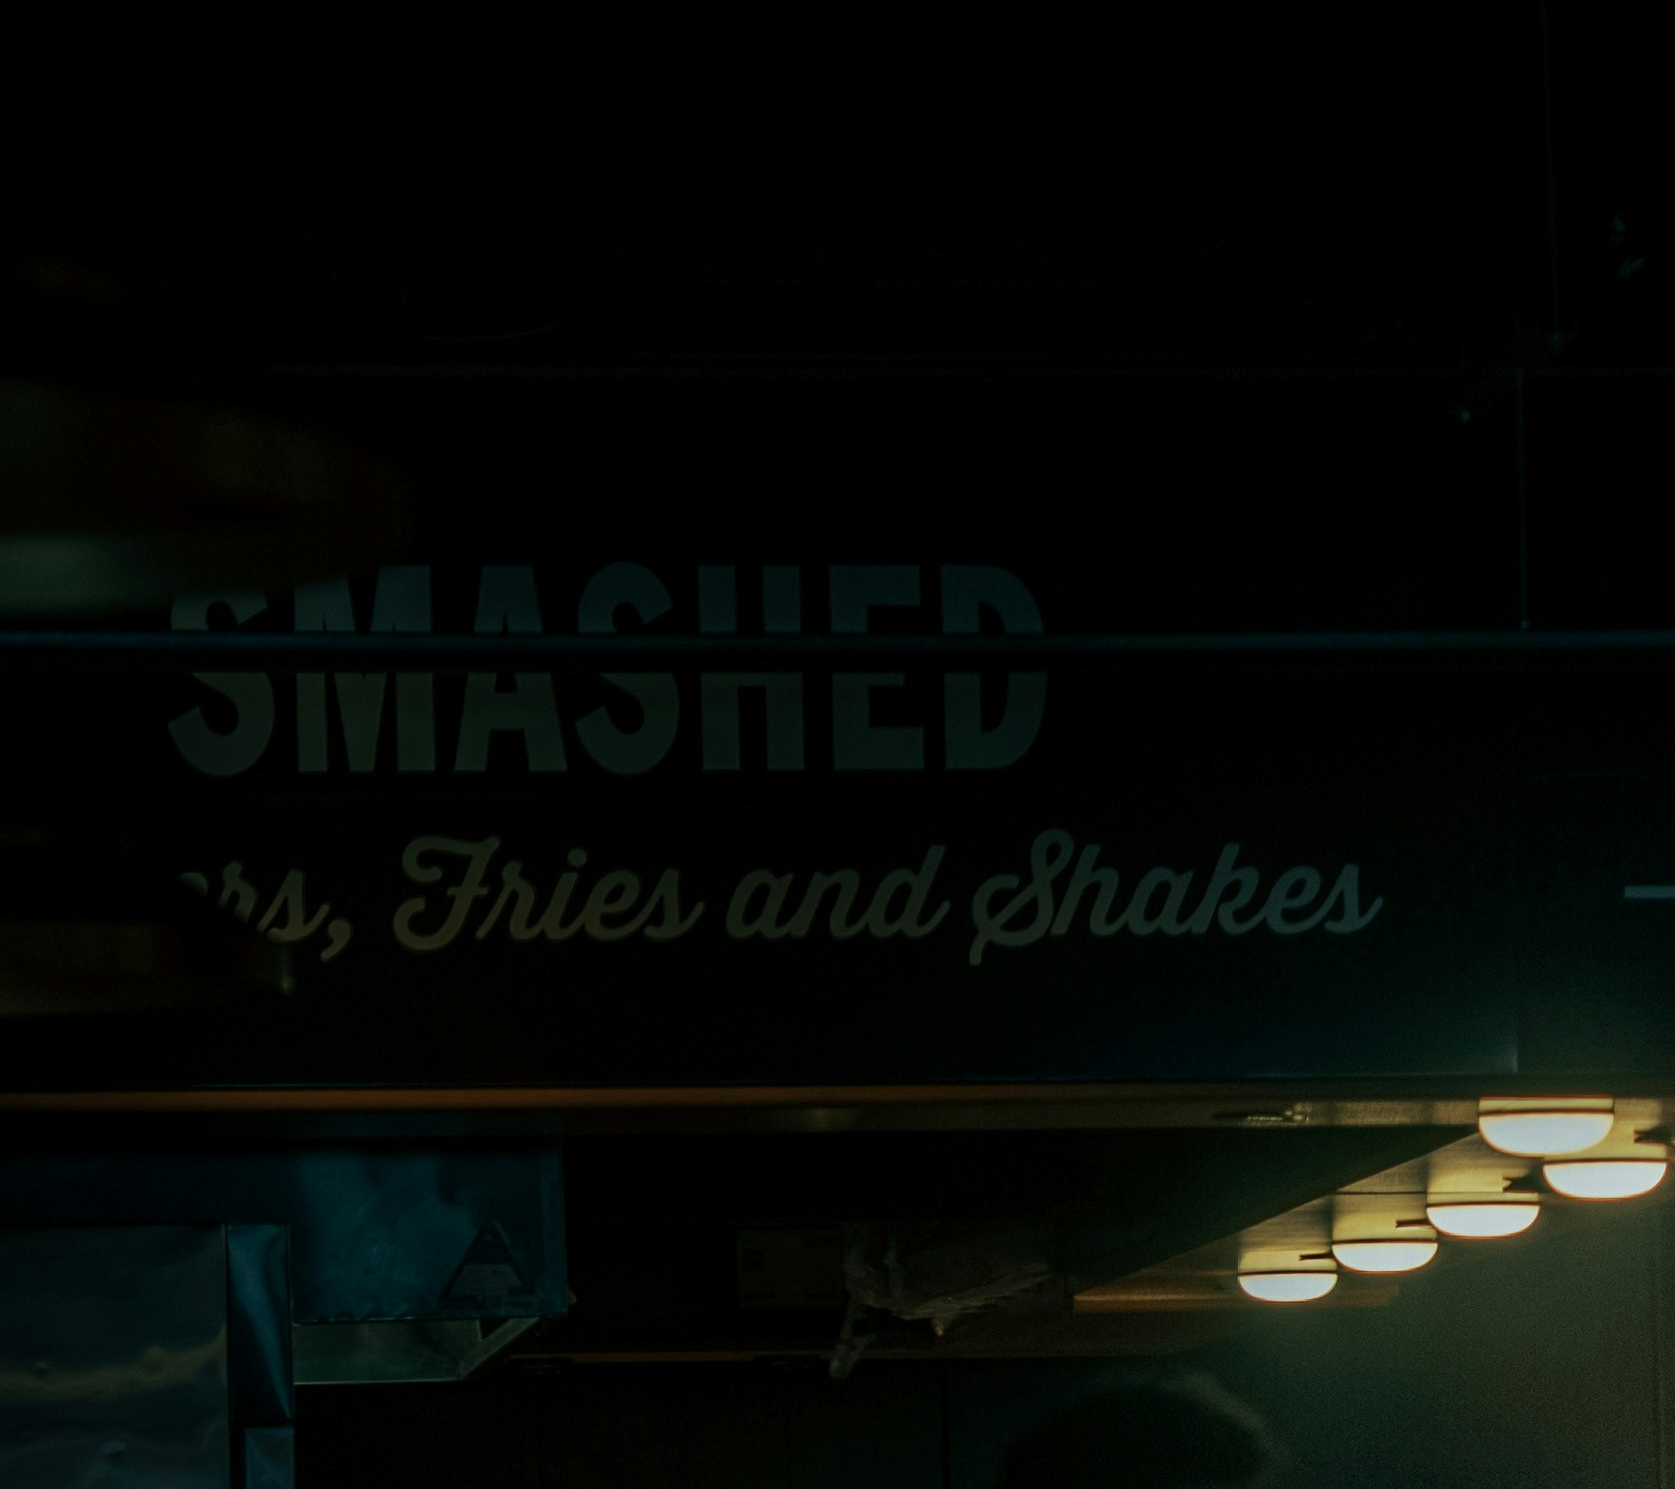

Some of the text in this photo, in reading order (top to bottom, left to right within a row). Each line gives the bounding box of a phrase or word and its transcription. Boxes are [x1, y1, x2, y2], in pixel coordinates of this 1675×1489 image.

[167, 560, 1048, 778] SMASHED
[392, 833, 706, 955] Fries
[725, 842, 952, 942] and
[970, 825, 1384, 967] Shakes
